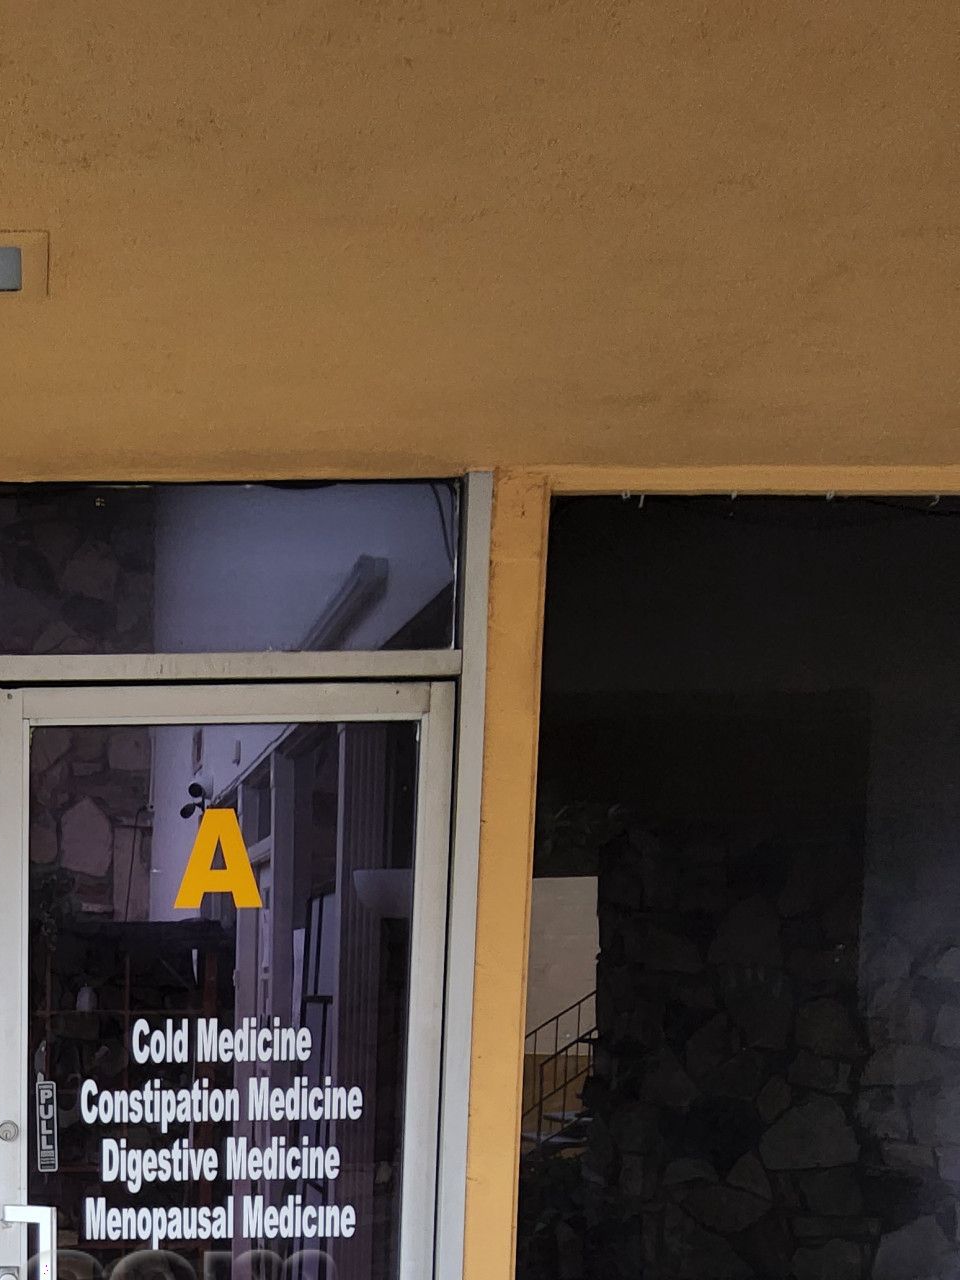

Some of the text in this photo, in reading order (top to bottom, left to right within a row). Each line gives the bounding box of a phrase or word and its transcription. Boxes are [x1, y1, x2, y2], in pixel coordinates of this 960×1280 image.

[173, 808, 263, 909] A
[132, 1017, 312, 1064] Cold Medicine
[39, 1088, 54, 1150] PULL
[80, 1076, 363, 1133] Constipation Medicine
[102, 1136, 340, 1193] Digestive Medicine
[85, 1195, 355, 1250] Menopausal Medicine
